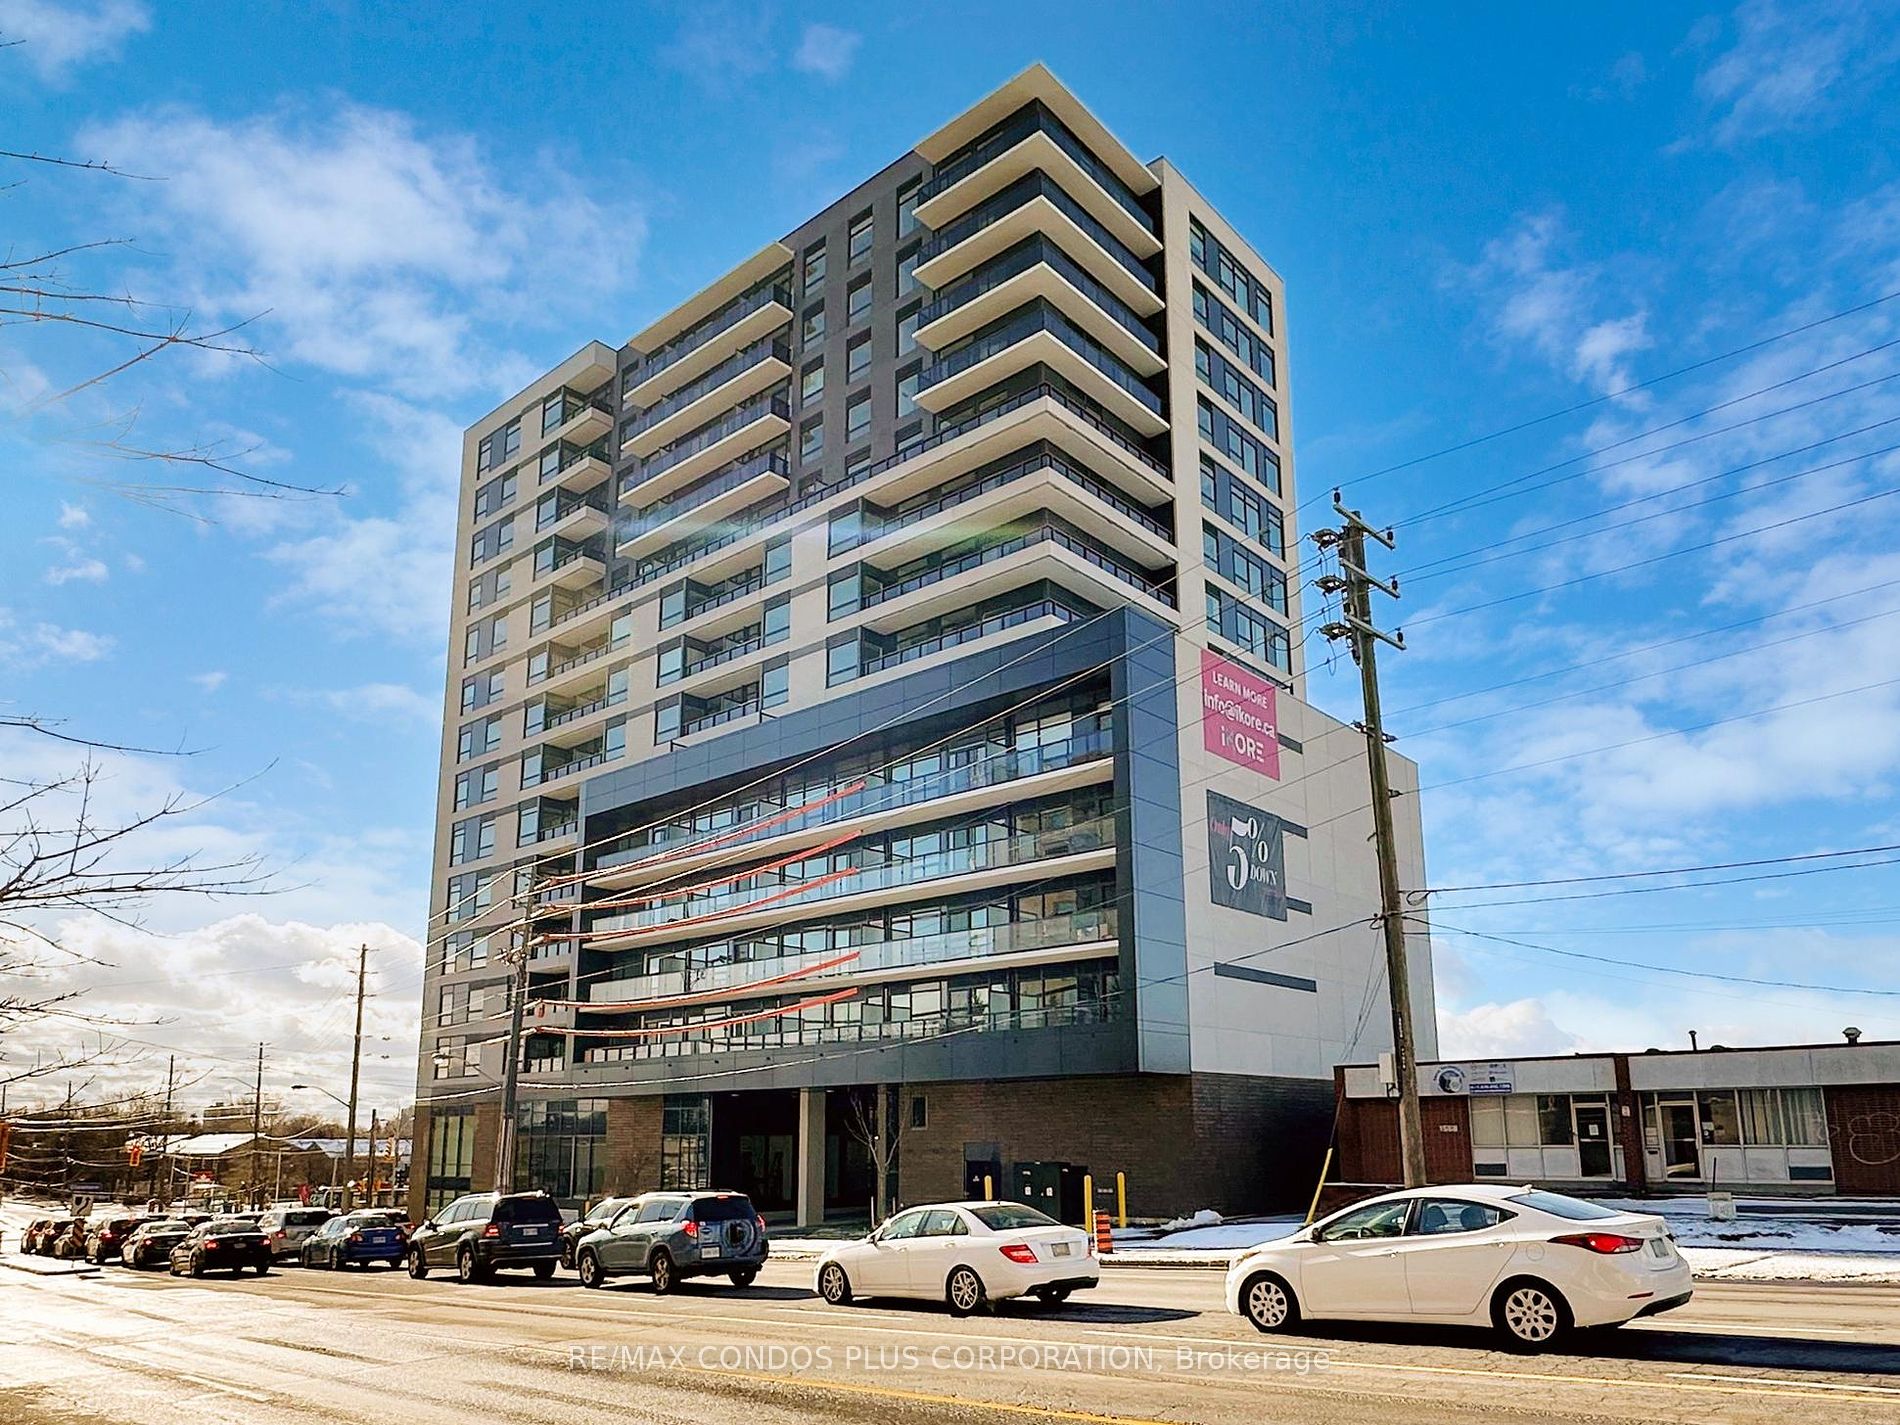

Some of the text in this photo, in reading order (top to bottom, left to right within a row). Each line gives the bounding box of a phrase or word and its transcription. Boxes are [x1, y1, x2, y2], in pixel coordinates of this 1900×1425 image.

[1212, 671, 1268, 709] LEARN MORE
[1250, 864, 1278, 886] DOWN
